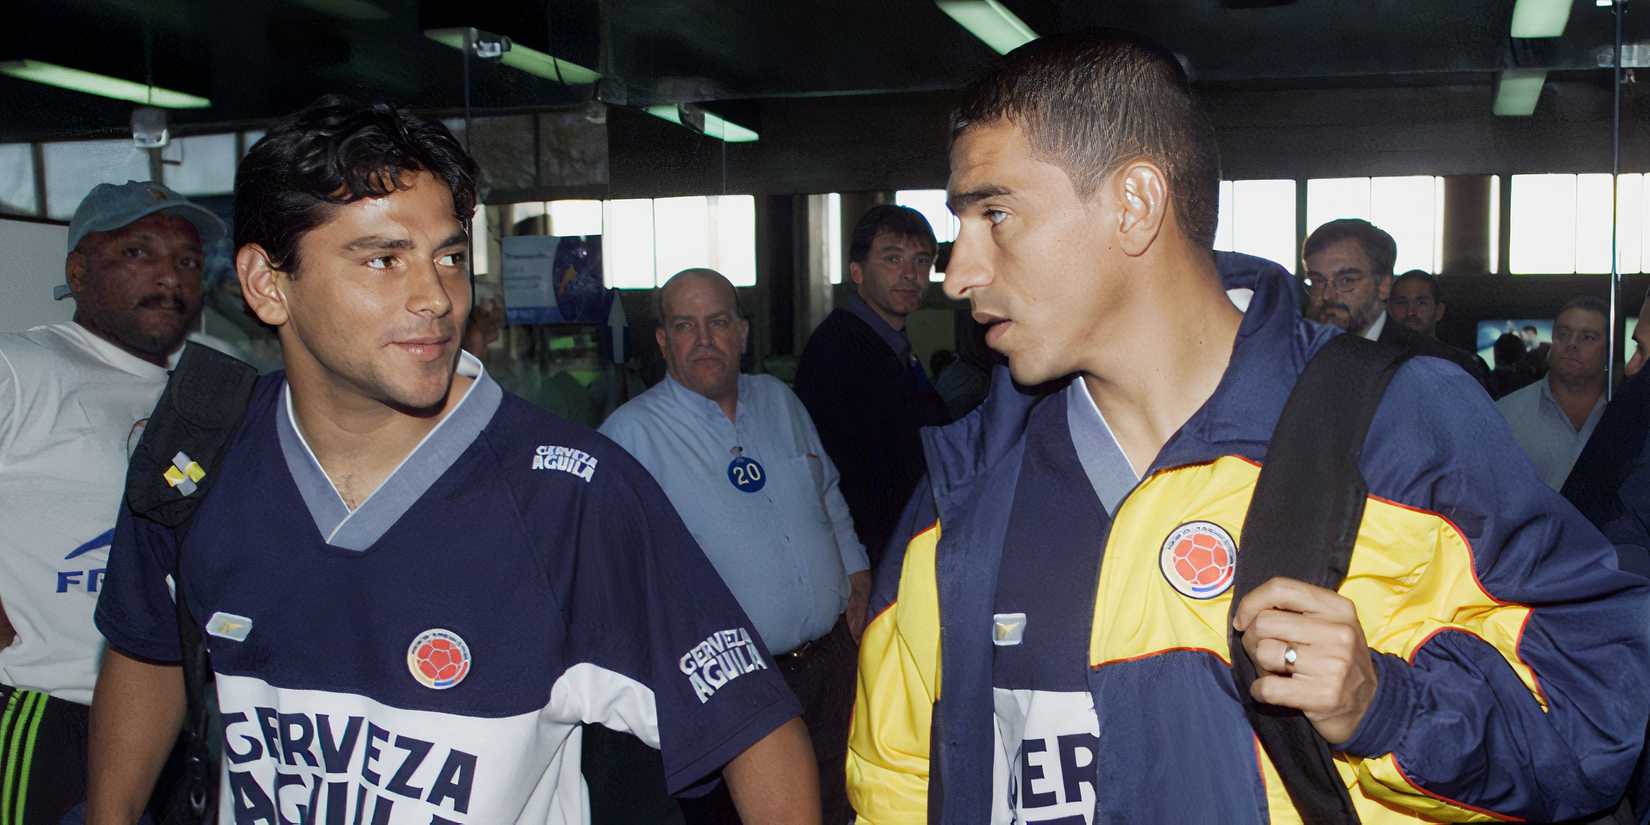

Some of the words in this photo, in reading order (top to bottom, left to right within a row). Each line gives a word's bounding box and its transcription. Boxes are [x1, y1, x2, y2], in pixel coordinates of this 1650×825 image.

[532, 455, 595, 482] AGUILA
[733, 463, 760, 485] 20
[689, 643, 768, 704] AGUILA
